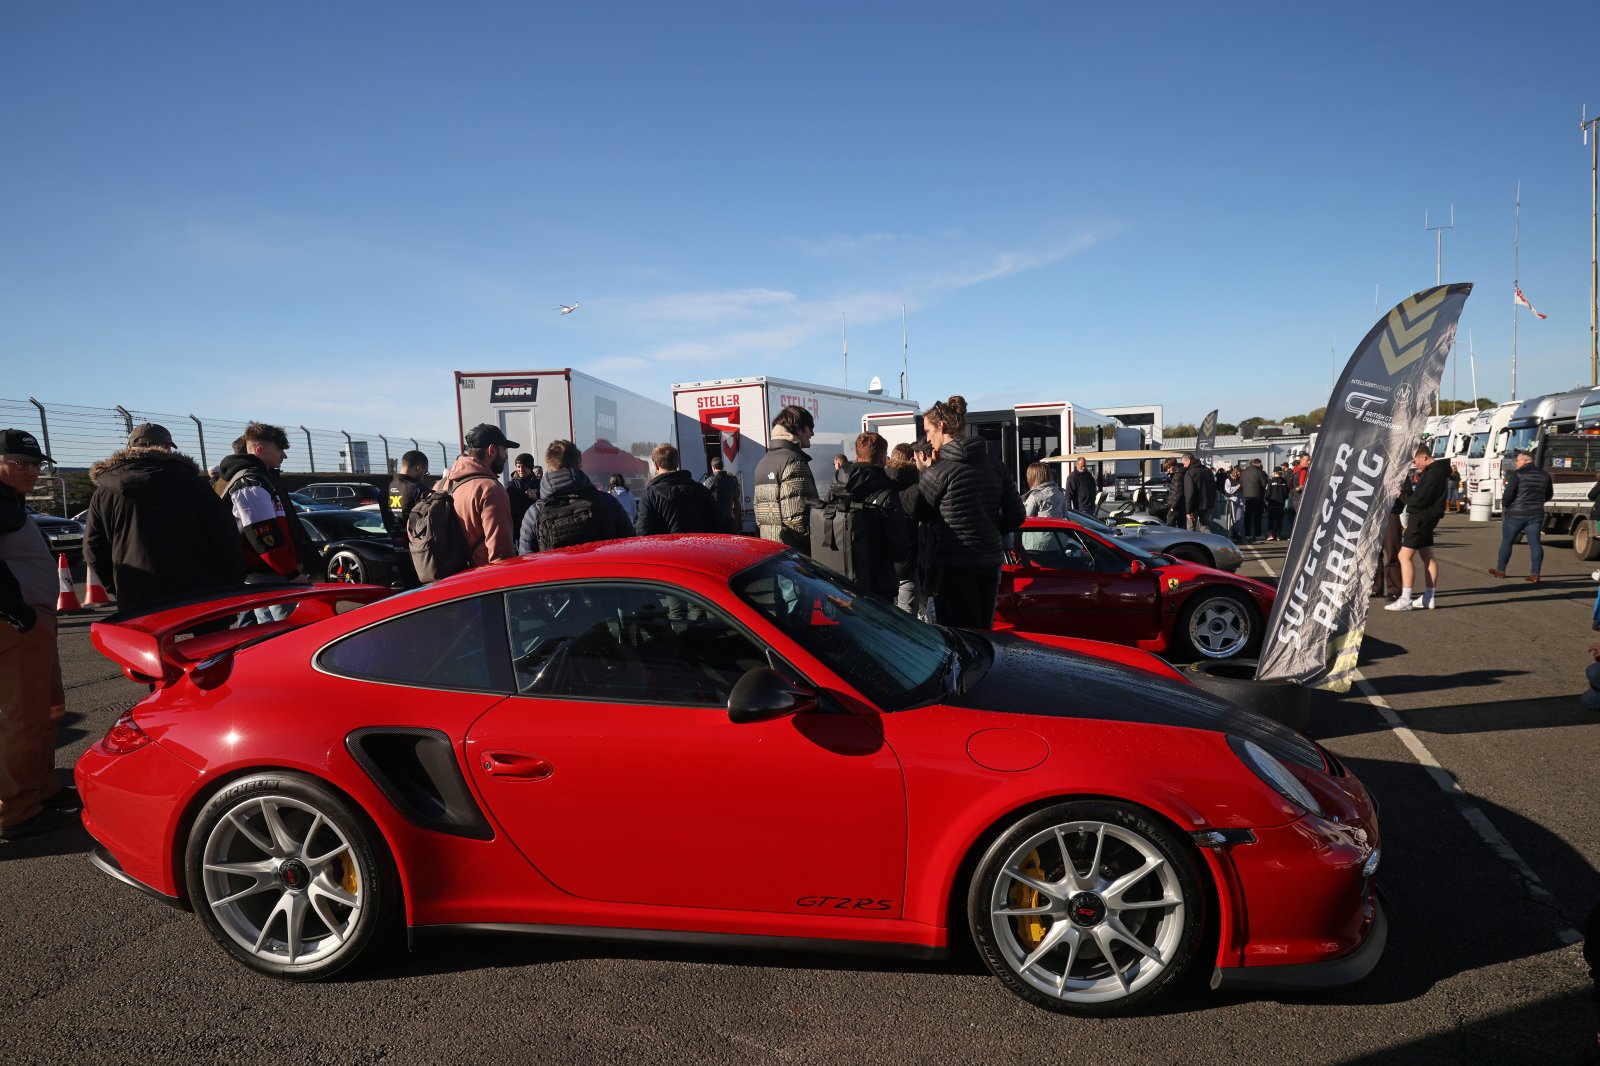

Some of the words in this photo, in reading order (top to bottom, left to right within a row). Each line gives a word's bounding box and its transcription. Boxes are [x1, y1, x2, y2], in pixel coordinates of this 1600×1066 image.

[494, 387, 532, 396] JMH
[697, 394, 740, 408] STELLER
[1365, 410, 1385, 420] BRITISH
[1362, 416, 1402, 430] CHAMPIONSHIP
[1313, 448, 1385, 632] PARKING
